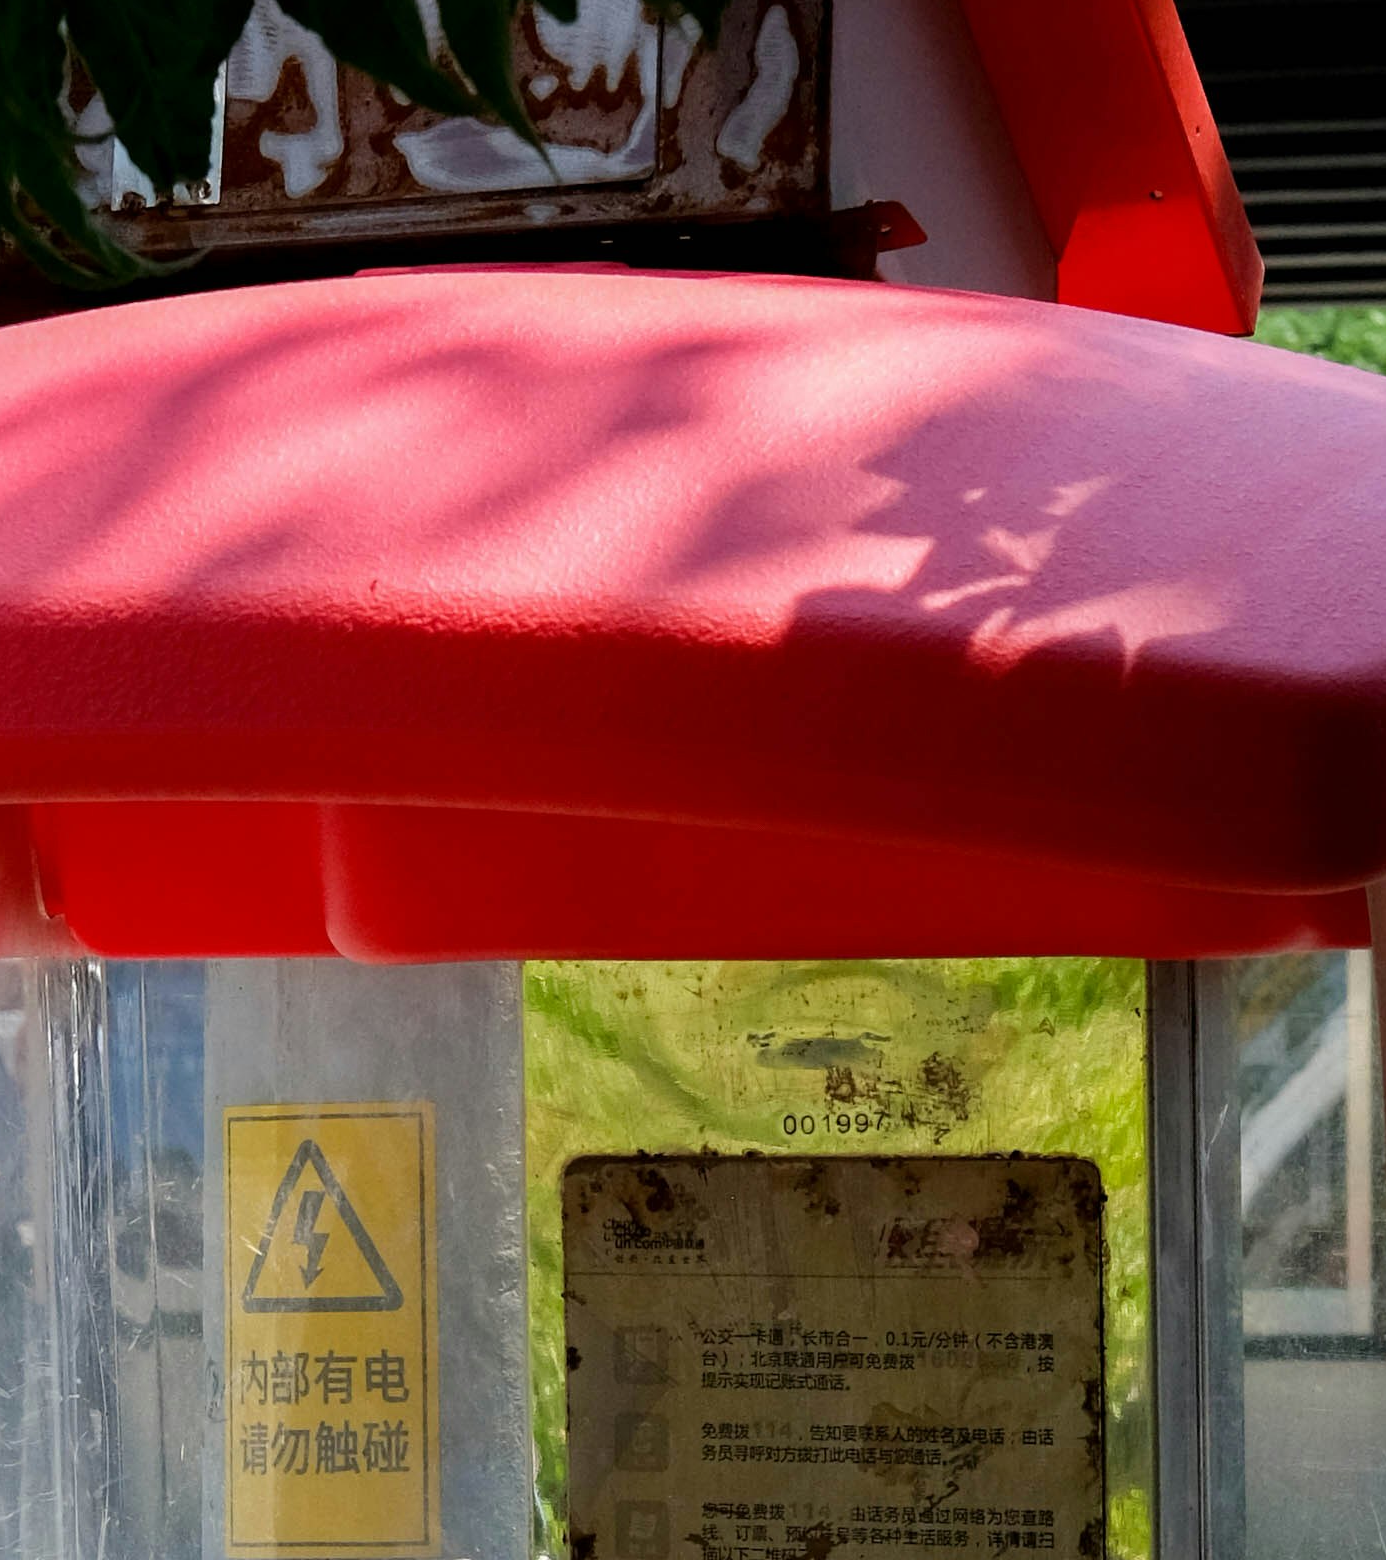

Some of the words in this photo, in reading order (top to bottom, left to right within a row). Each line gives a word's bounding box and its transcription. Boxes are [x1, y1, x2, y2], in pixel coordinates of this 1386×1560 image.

[782, 1111, 886, 1136] 001997
[239, 1349, 410, 1405] 内部有电
[239, 1419, 410, 1476] 请勿触碰
